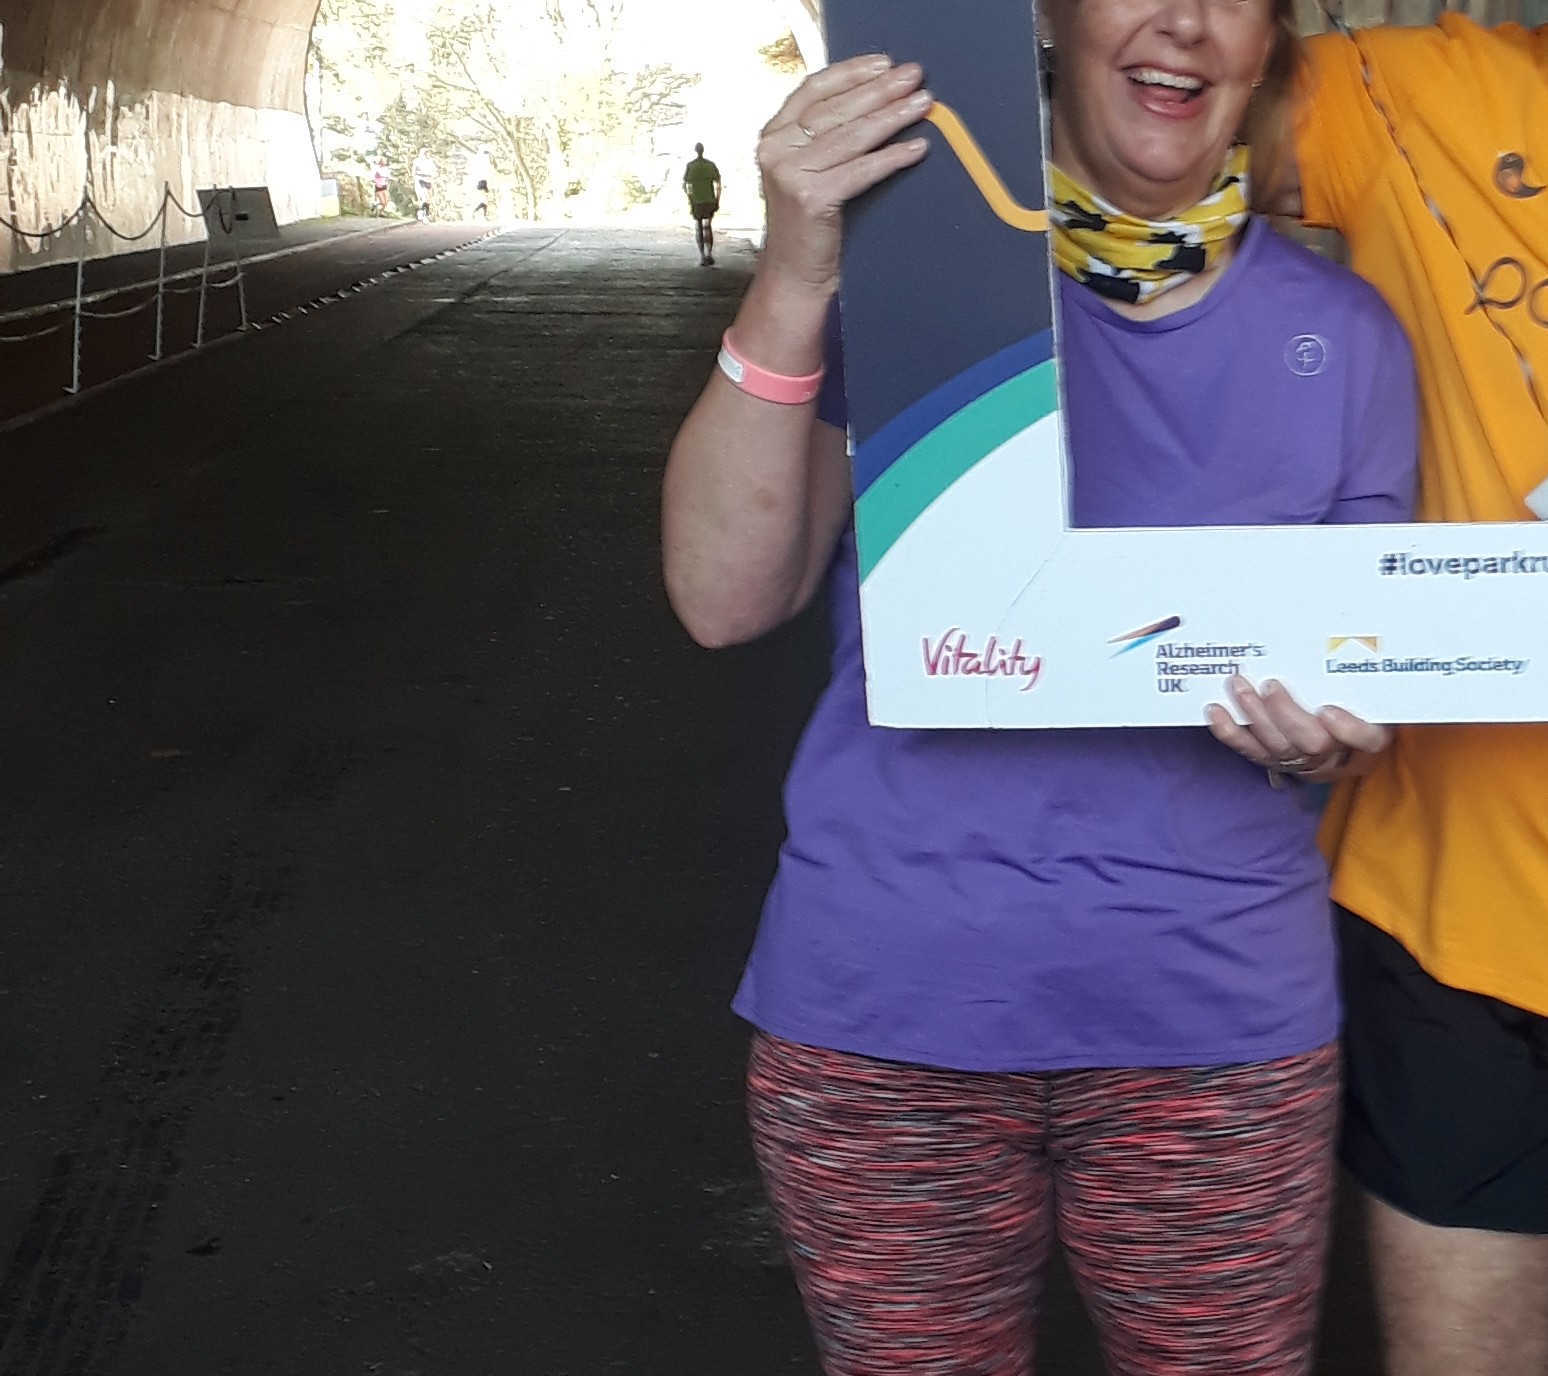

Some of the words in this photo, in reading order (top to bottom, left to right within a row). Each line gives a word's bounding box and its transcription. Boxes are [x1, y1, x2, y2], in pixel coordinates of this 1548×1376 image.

[1155, 641, 1267, 659] Alzheimer's
[921, 627, 1044, 692] Vitality
[1157, 659, 1240, 677] Research
[1326, 656, 1379, 674] Leeds
[1381, 656, 1455, 676] Building
[1455, 656, 1528, 676] Society
[1157, 677, 1187, 694] UK
